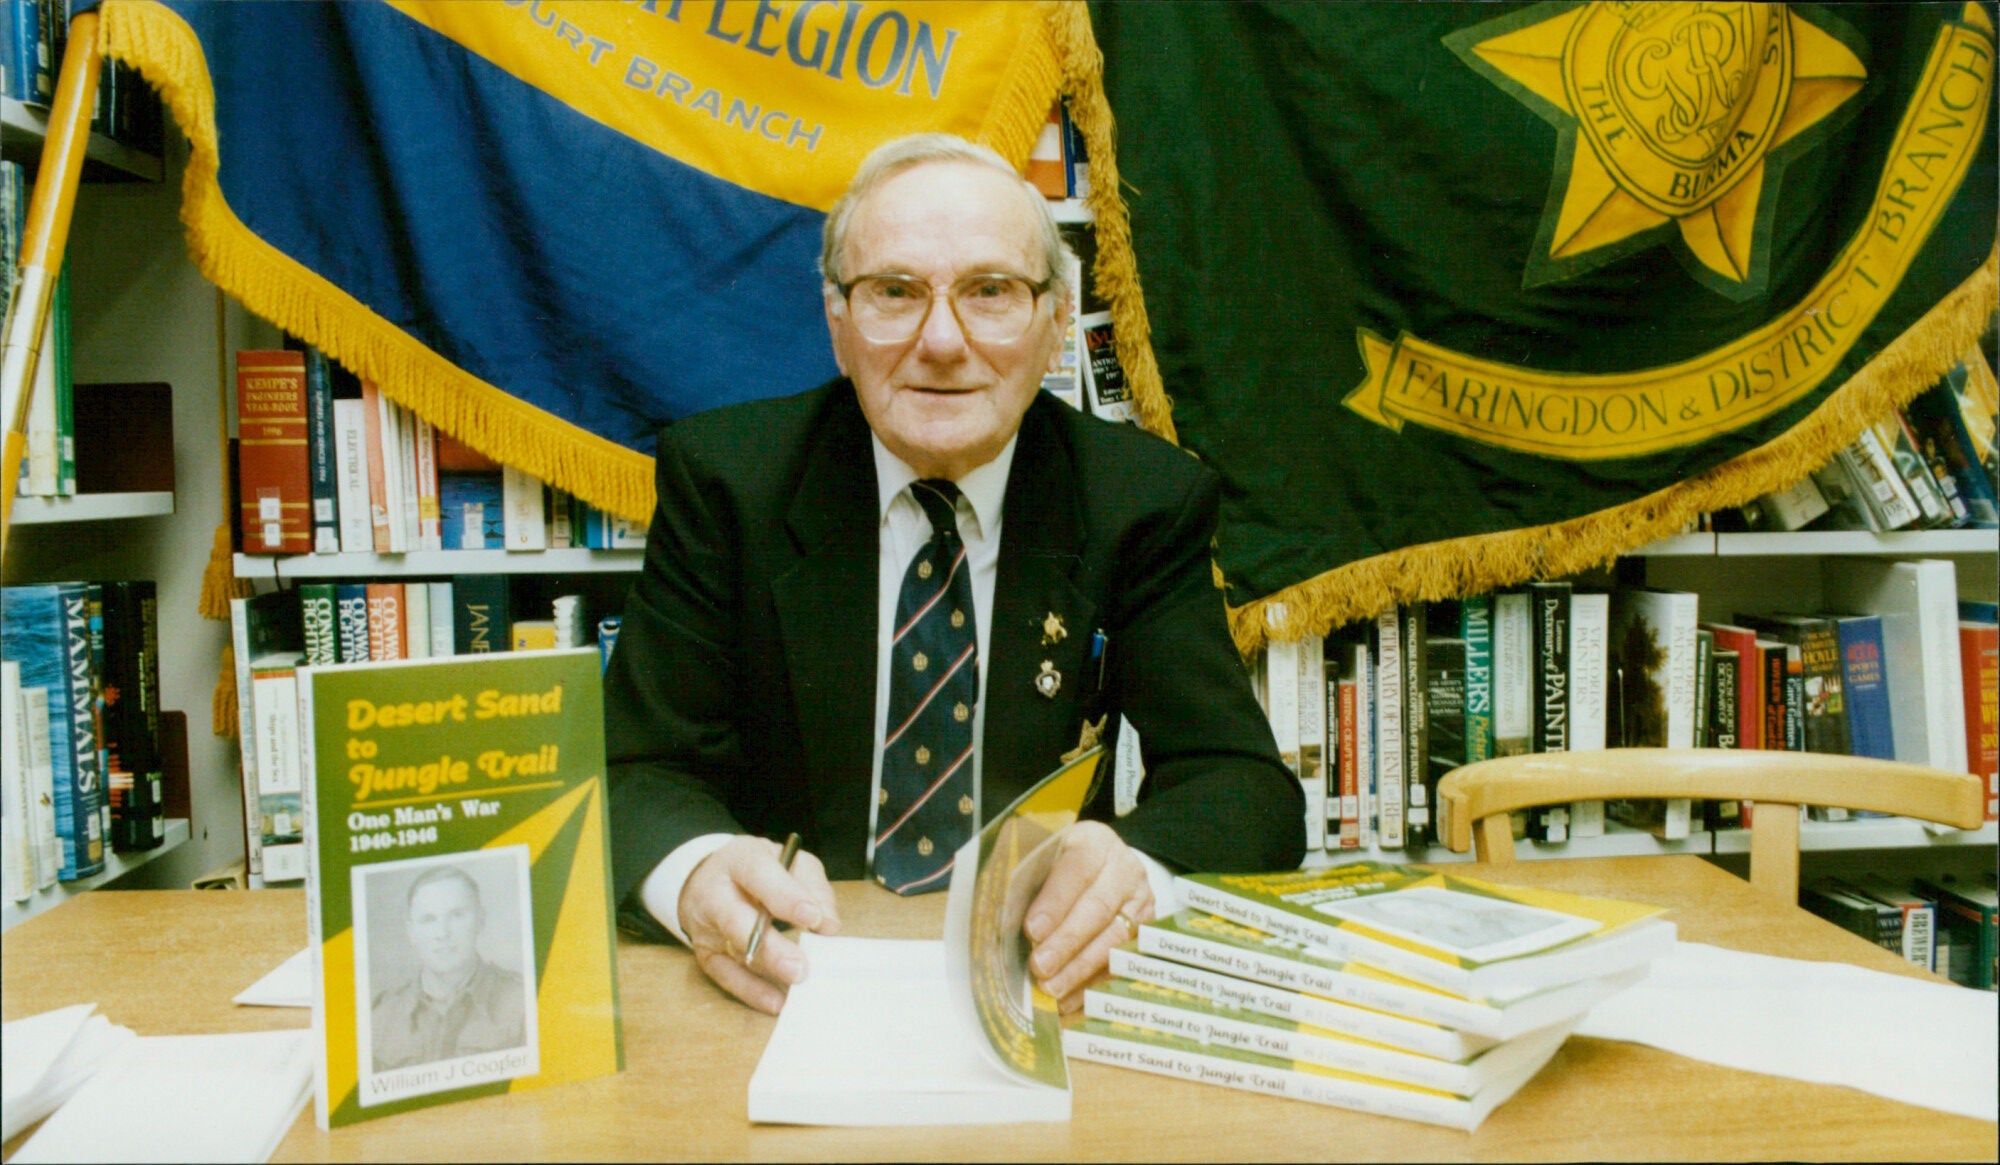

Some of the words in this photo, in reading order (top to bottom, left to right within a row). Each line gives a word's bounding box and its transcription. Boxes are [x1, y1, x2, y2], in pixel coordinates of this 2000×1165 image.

[705, 0, 962, 99] LEGION
[622, 55, 826, 153] BRANCH
[1581, 81, 1635, 152] THE
[1400, 360, 1668, 436] FARINGDON
[1679, 399, 1702, 421] &
[1707, 254, 1885, 412] DISTRICT
[1876, 40, 1990, 243] BRANCH
[245, 377, 298, 390] KEMPE'S
[245, 391, 298, 402] ENGINEERS
[345, 428, 361, 492] ELECTRICAL
[1408, 618, 1417, 657] CONCISE
[1503, 619, 1514, 670] CENTURY
[1542, 599, 1559, 658] Dictionary
[1380, 606, 1398, 701] DICTIONARY
[1544, 659, 1559, 673] of
[1576, 626, 1589, 705] PAINTERS
[1588, 625, 1601, 720] VICTORIAN
[1672, 626, 1685, 705] PAINTERS
[1803, 648, 1838, 664] HOYLE
[65, 598, 97, 793] MAMMALS
[1409, 660, 1418, 732] ENCYCLOPEDIA
[1503, 672, 1514, 722] PAINTERS
[1787, 678, 1797, 705] Card
[1849, 673, 1880, 684] GAMES
[346, 694, 468, 731] Desert
[473, 685, 562, 720] Sand
[1381, 704, 1398, 722] OF
[1718, 712, 1727, 724] OF
[1787, 707, 1797, 748] Games
[270, 738, 279, 752] and
[271, 754, 280, 765] the
[346, 738, 378, 759] to
[1344, 728, 1353, 758] CRAFT
[1410, 734, 1418, 747] OF
[349, 755, 470, 801] Jungle
[477, 744, 559, 779] Trail
[347, 811, 391, 831] One
[394, 802, 453, 826] Man's
[460, 799, 501, 818] War
[349, 826, 438, 853] 1940-1946
[1188, 888, 1220, 909] Desert
[1222, 900, 1249, 920] Sand
[1250, 911, 1262, 923] to
[1265, 914, 1299, 937] Jungle
[1303, 926, 1329, 945] Trail
[1127, 960, 1165, 980] Desert
[1168, 972, 1198, 989] Sand
[1201, 981, 1213, 992] to
[1216, 983, 1257, 1003] Jungle
[1260, 992, 1292, 1013] Trail
[1158, 937, 1197, 955] Desert
[1202, 949, 1233, 967] Sand
[1236, 958, 1249, 971] to
[1253, 960, 1298, 984] Jungle
[1301, 971, 1333, 991] Trail
[1103, 1002, 1146, 1021] Desert
[1150, 1011, 1184, 1029] Sand
[1187, 1020, 1200, 1033] to
[1205, 1024, 1250, 1045] Jungle
[1255, 1034, 1289, 1052] Trail
[370, 1068, 439, 1096] William
[444, 1064, 456, 1082] J
[461, 1053, 528, 1079] Cooper
[1087, 1043, 1133, 1061] Desert
[1137, 1051, 1173, 1070] Sand
[1177, 1061, 1192, 1073] to
[1196, 1064, 1244, 1085] Jungle
[1249, 1074, 1286, 1092] Trail
